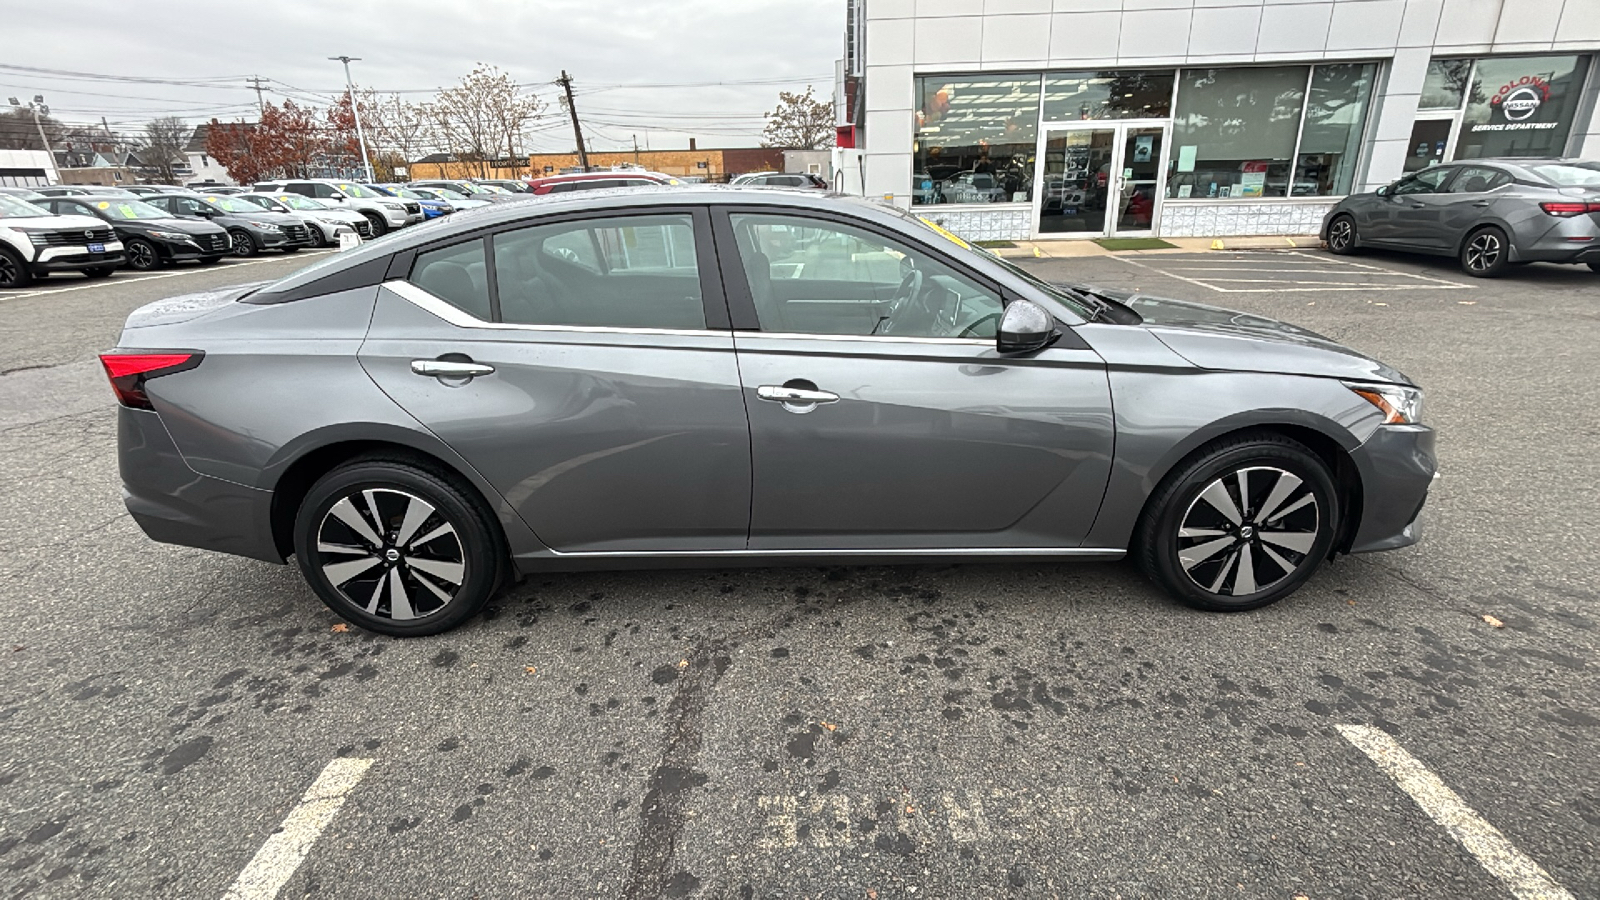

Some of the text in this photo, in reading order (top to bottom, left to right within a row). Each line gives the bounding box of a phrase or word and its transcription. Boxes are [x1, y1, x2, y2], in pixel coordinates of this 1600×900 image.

[1505, 101, 1537, 109] NISSAN
[1471, 122, 1558, 132] SERVICE DEPARTMENT
